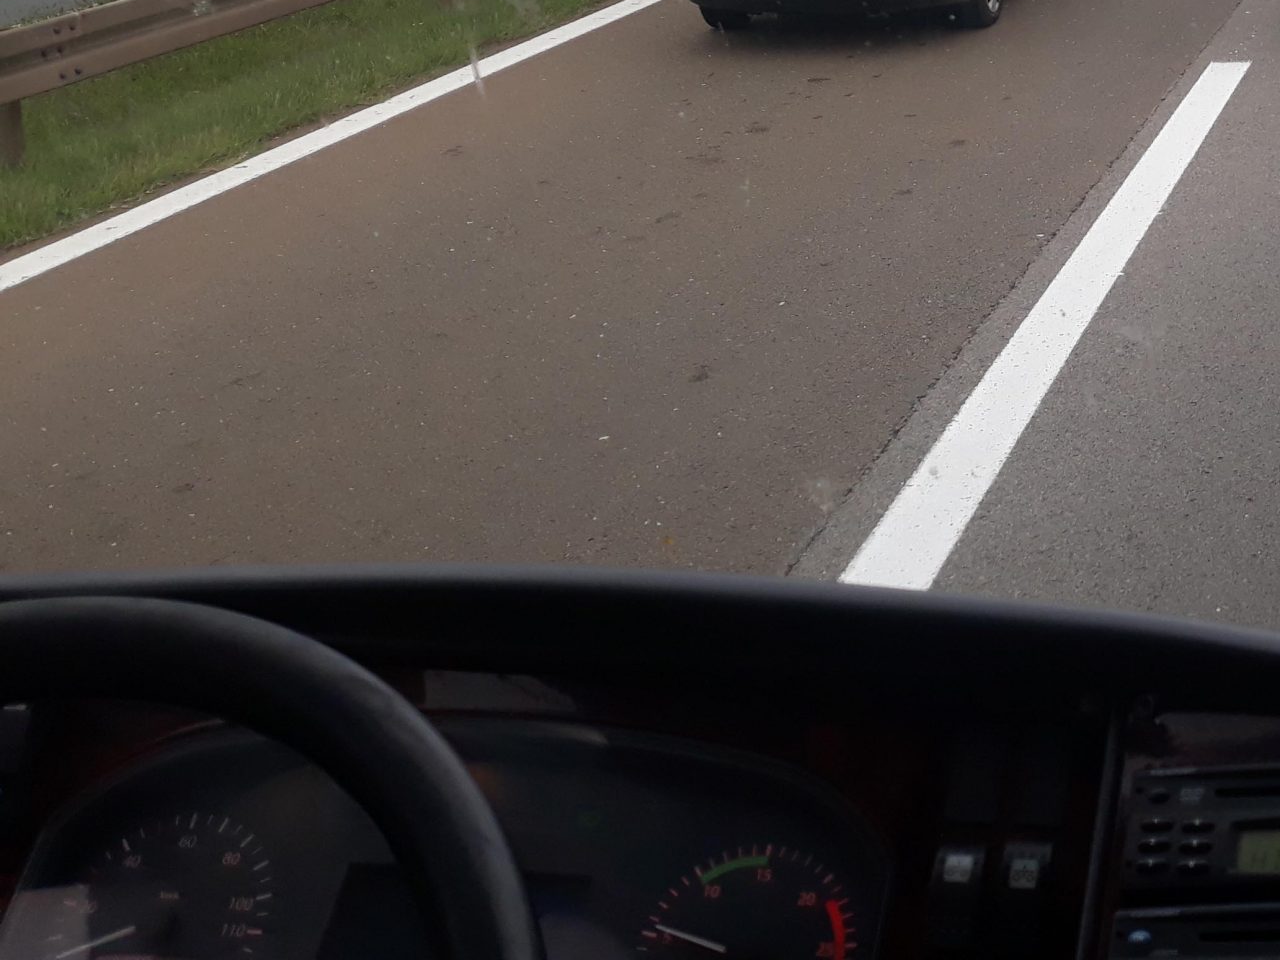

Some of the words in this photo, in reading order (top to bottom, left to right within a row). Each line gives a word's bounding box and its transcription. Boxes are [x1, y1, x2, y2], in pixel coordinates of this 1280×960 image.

[222, 851, 242, 866] 80
[756, 868, 774, 883] 15
[703, 884, 722, 899] 10
[797, 891, 817, 907] 20
[221, 923, 247, 938] 110
